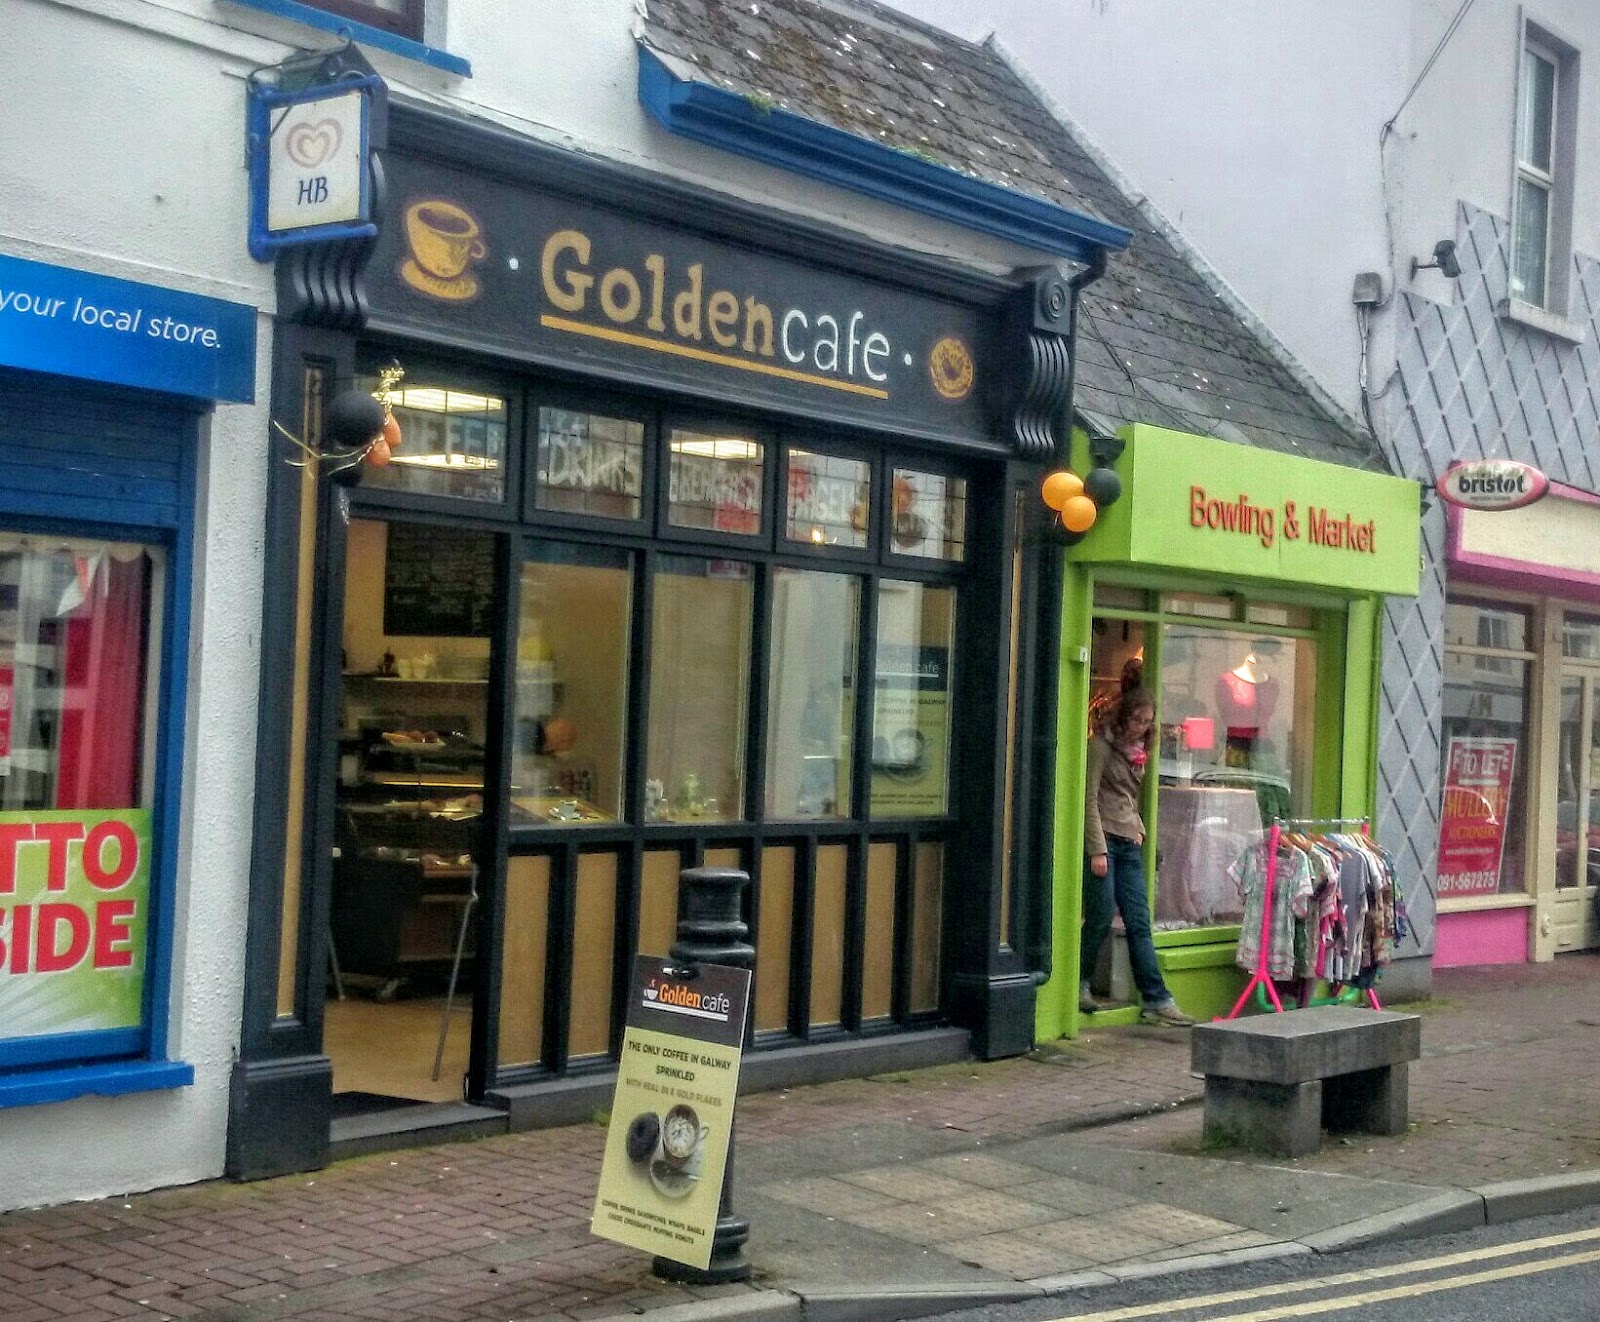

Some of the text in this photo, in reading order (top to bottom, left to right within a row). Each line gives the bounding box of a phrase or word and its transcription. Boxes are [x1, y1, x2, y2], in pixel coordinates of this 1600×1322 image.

[298, 176, 328, 205] HB
[0, 289, 221, 348] your local store.
[1190, 485, 1376, 554] Bowling & Market
[1462, 754, 1477, 774] TO
[1481, 754, 1503, 775] LET
[629, 1041, 732, 1071] THE ONLY COFFEE IN GALWAY
[655, 1065, 695, 1082] SPRINKLED
